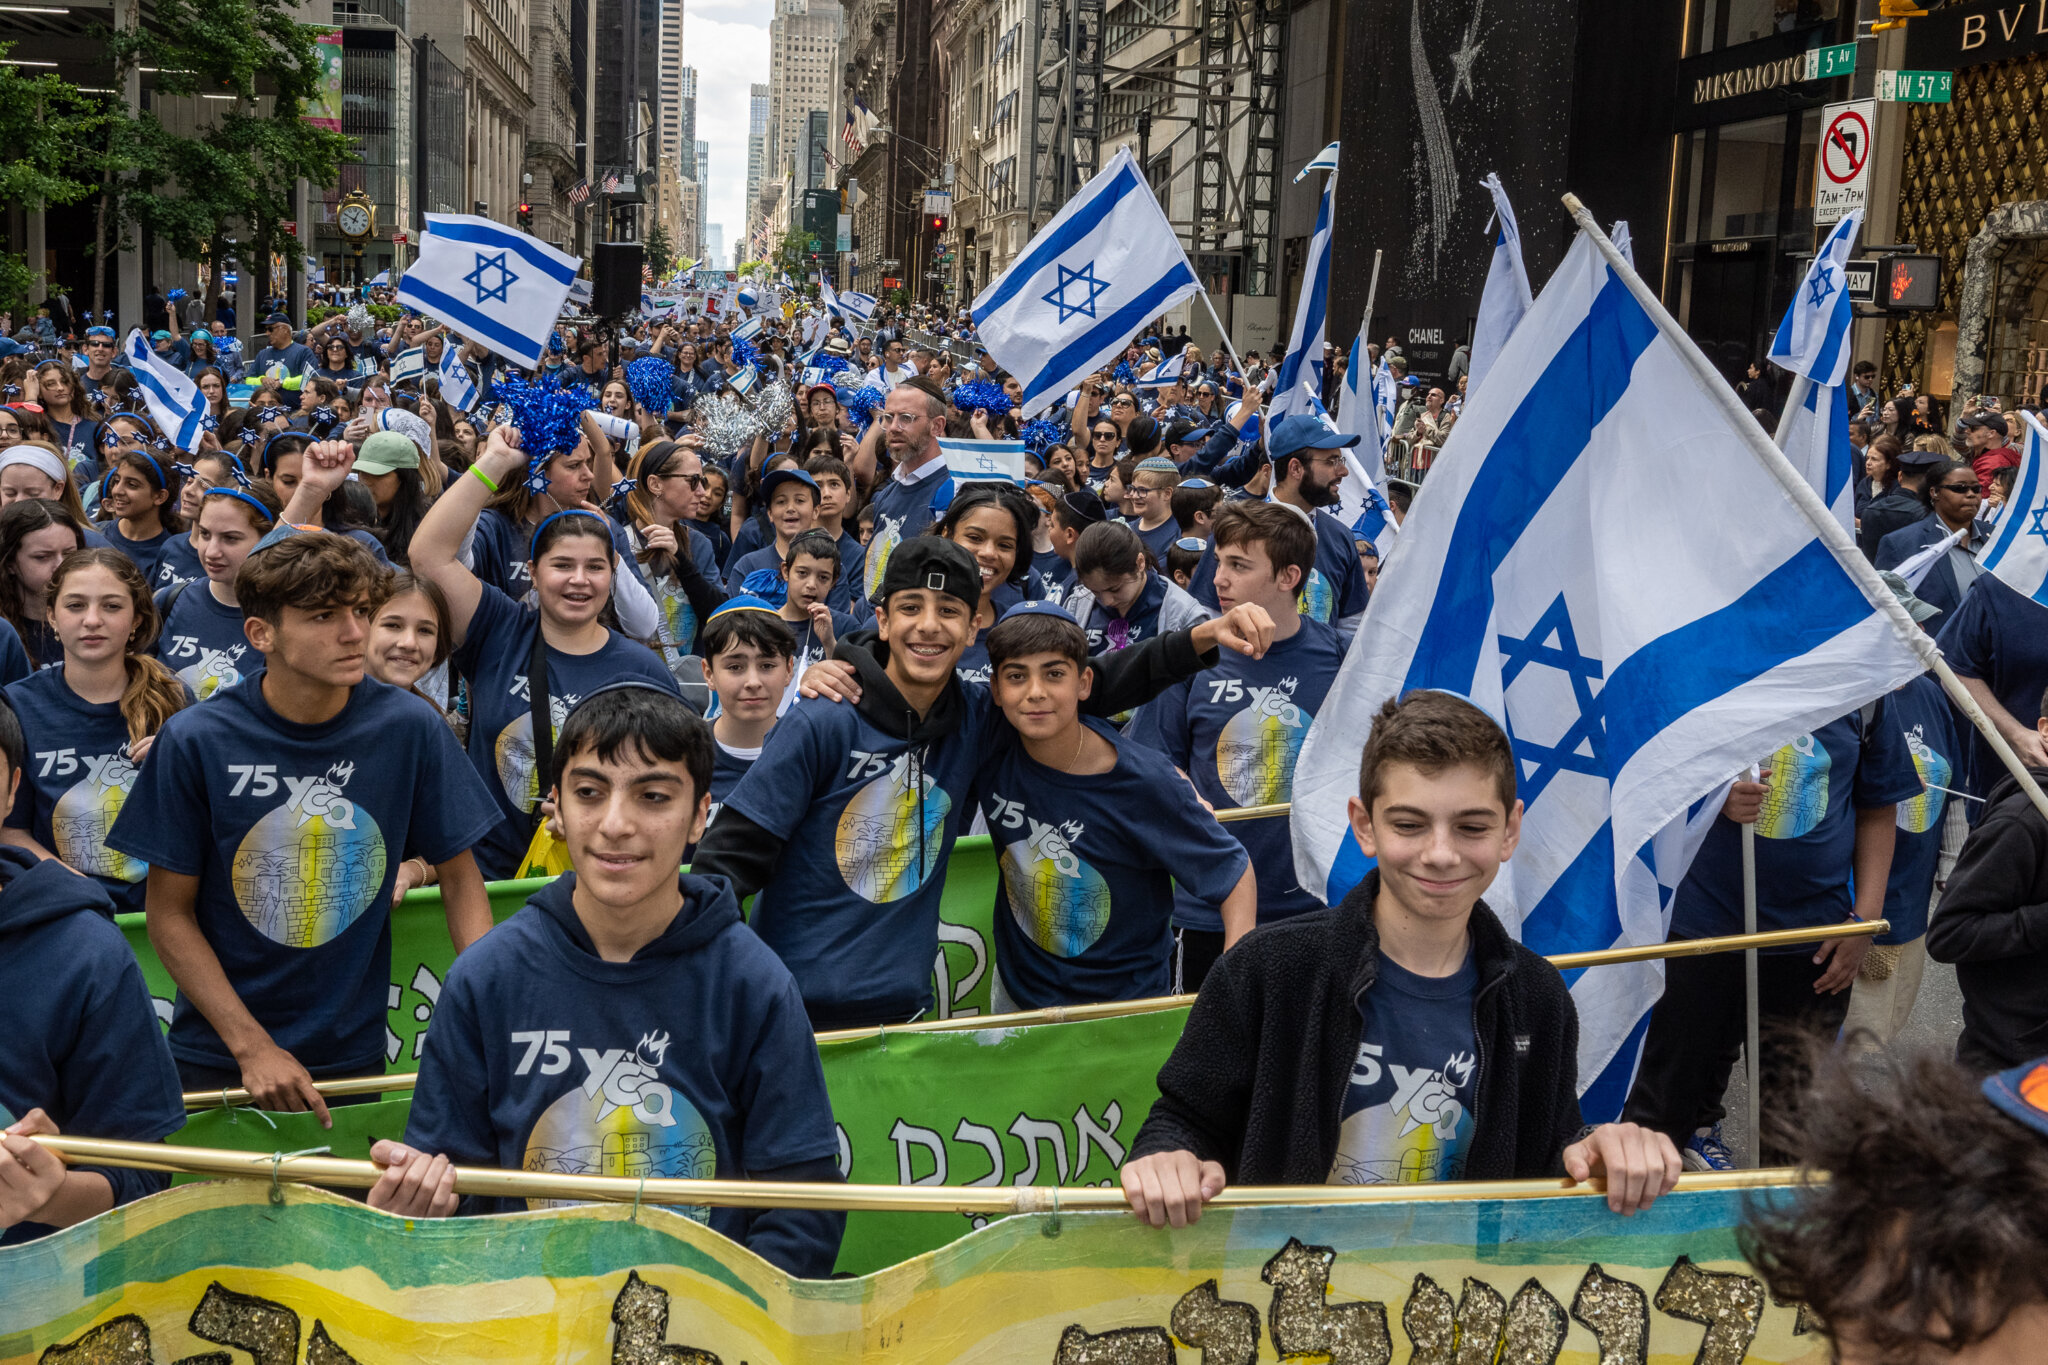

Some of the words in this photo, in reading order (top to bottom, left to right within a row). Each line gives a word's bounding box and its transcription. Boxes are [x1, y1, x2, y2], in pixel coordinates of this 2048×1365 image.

[1826, 51, 1834, 74] 5
[1839, 49, 1850, 63] Av
[1694, 54, 1806, 104] MIKIMOTO
[1898, 75, 1912, 98] W
[1917, 76, 1935, 99] 57
[1940, 76, 1950, 91] St
[1819, 207, 1840, 216] EXCEPT
[1408, 328, 1445, 345] CHANEL
[168, 635, 198, 657] 75
[1209, 679, 1244, 703] 75
[35, 748, 78, 777] 75
[847, 750, 888, 779] 75
[228, 764, 279, 797] 75
[282, 776, 357, 830] YCQ
[989, 792, 1026, 829] 75
[1350, 1042, 1383, 1086] 5
[511, 1030, 572, 1076] 75
[578, 1047, 678, 1128] YCQ
